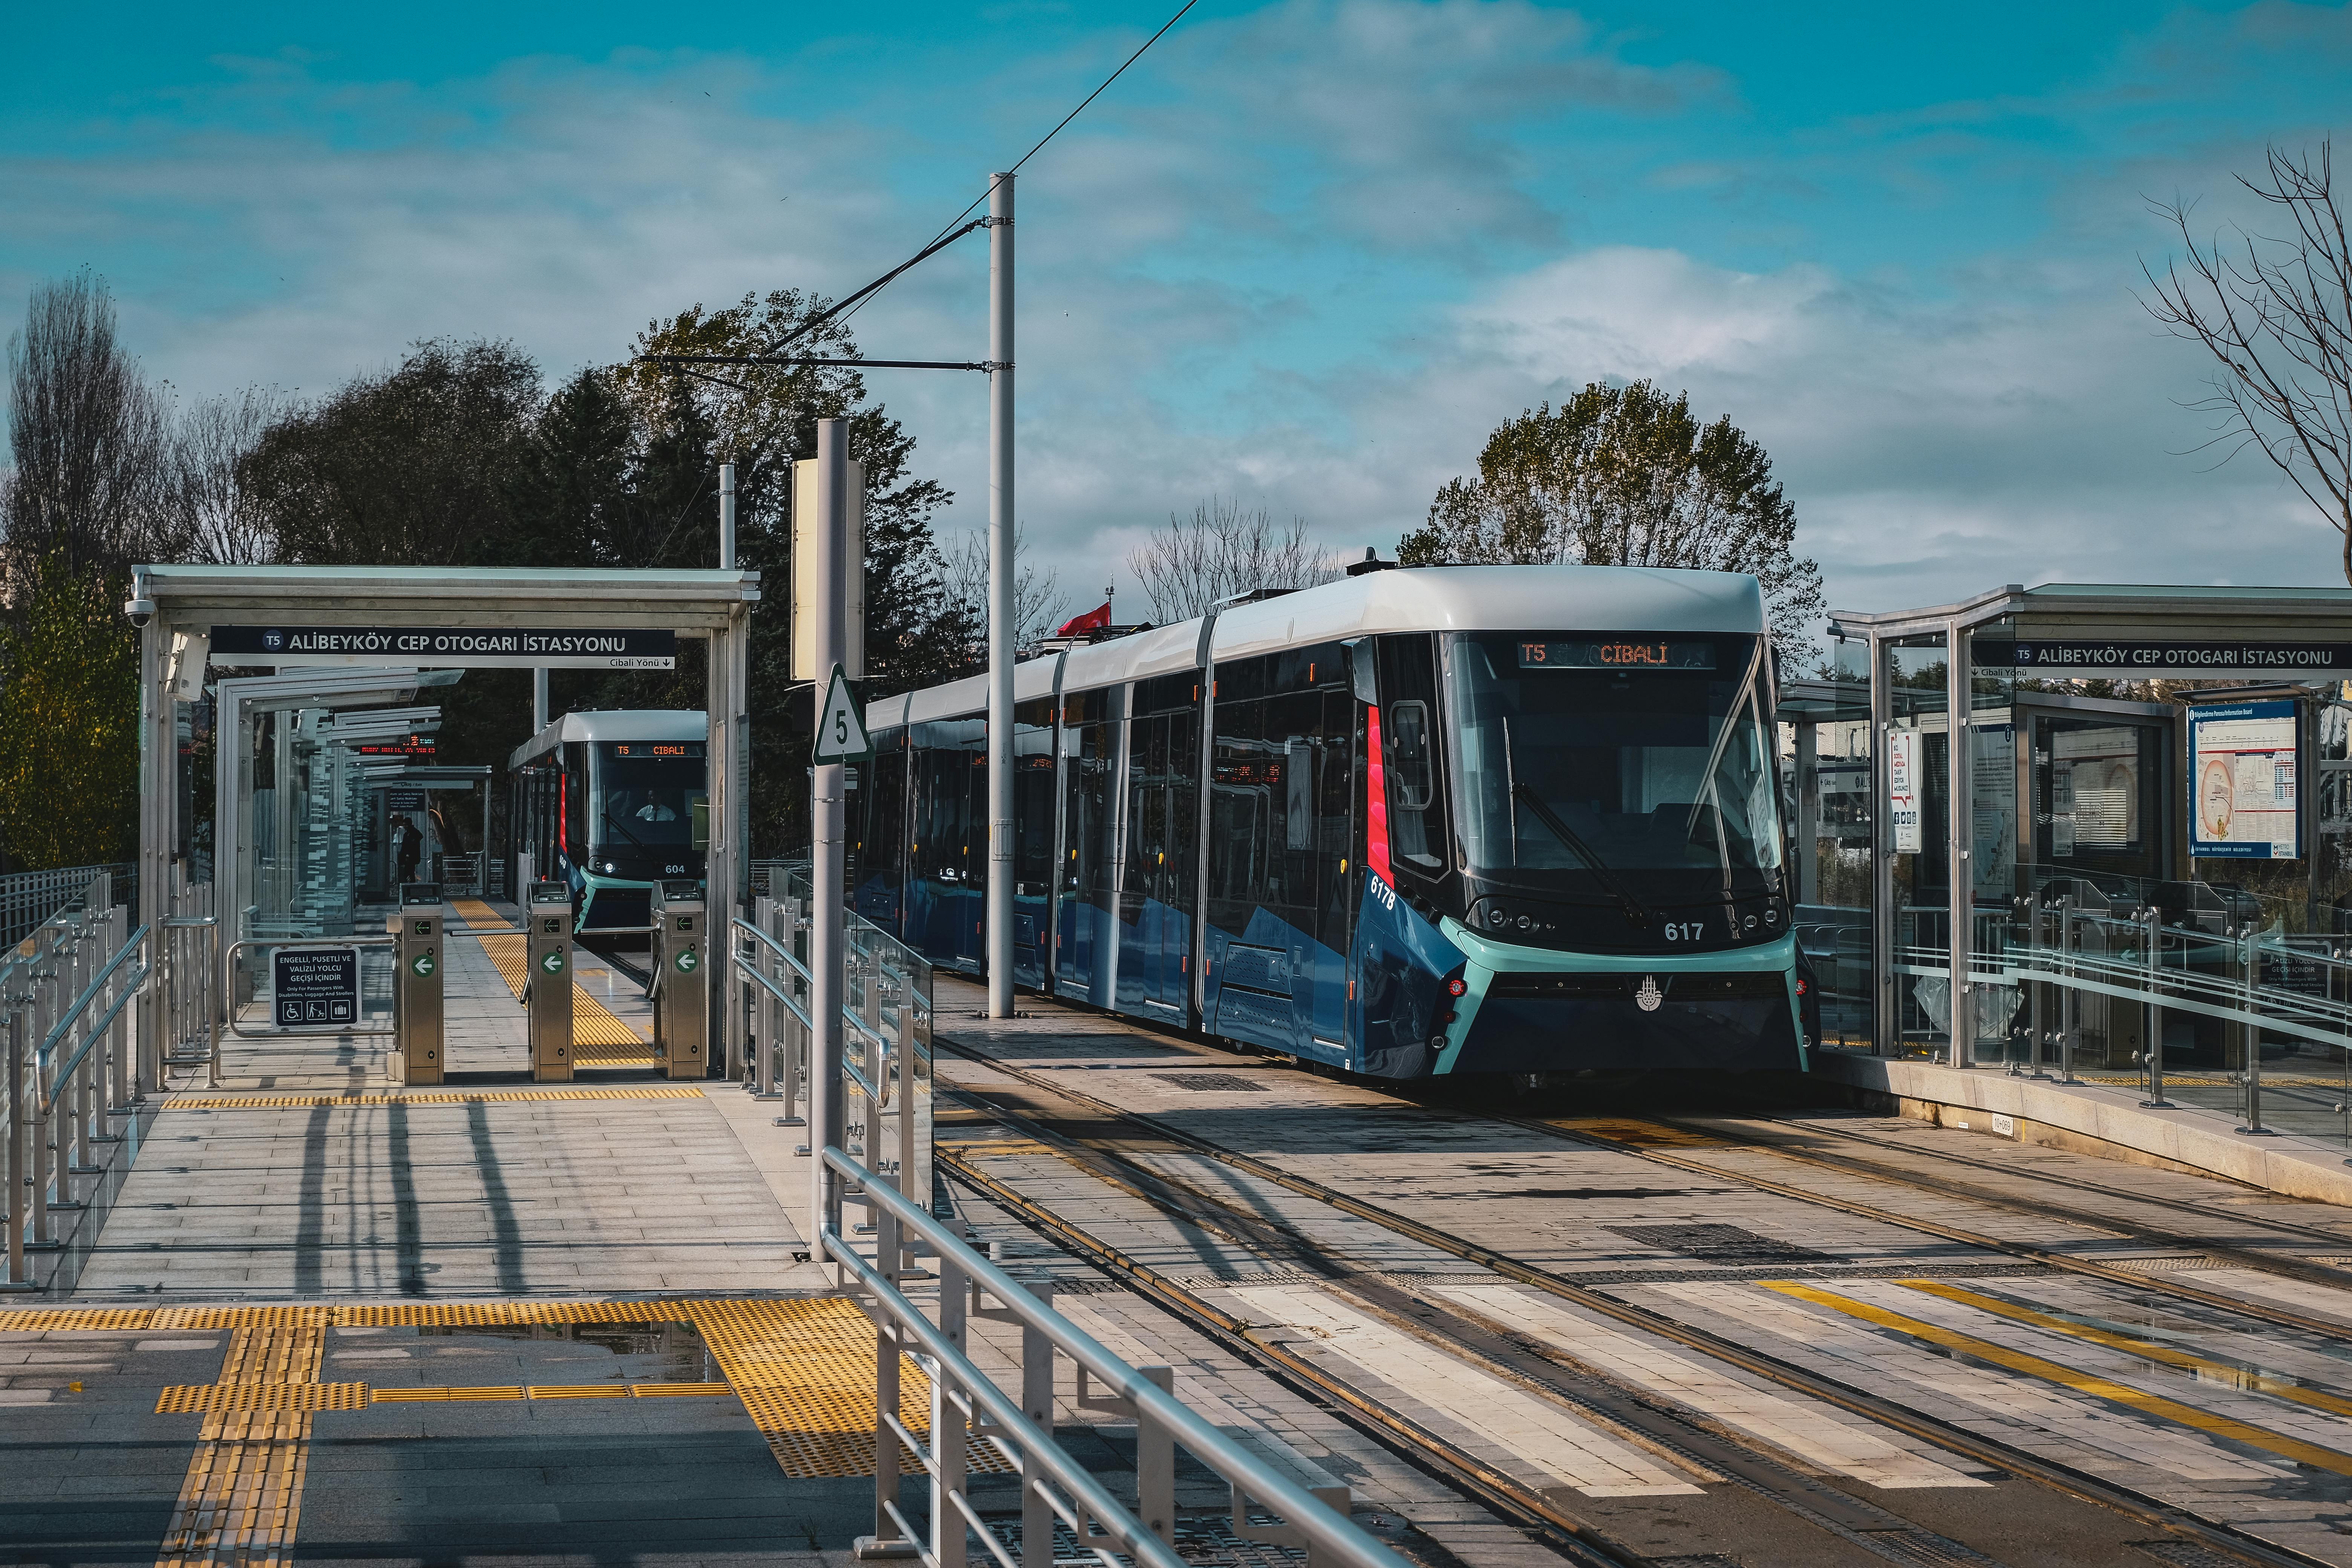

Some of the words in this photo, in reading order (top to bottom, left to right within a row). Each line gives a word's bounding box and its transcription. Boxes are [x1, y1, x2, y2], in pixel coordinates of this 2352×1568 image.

[266, 635, 280, 645] T5
[289, 632, 392, 649] ALİBEYKÖY
[398, 636, 429, 650] CEP
[435, 636, 517, 651] OTOGARI
[524, 634, 625, 652] İSTASYONU
[1522, 644, 1545, 662] T5
[2018, 650, 2030, 659] T5
[2038, 646, 2127, 663] ALİBEYKÖY
[2133, 650, 2161, 663] CEP
[2165, 650, 2237, 663] OTOGARI
[2243, 648, 2332, 664] İSTASYONU
[836, 709, 848, 745] 5
[618, 746, 629, 755] T5
[654, 746, 684, 755] CIBALI
[666, 865, 685, 874] 604
[1371, 875, 1396, 910] 617B
[1664, 923, 1704, 941] 617
[291, 974, 313, 983] GEÇİŞİ
[315, 973, 341, 982] İÇİNDİR
[1995, 1118, 2010, 1131] 10+069
